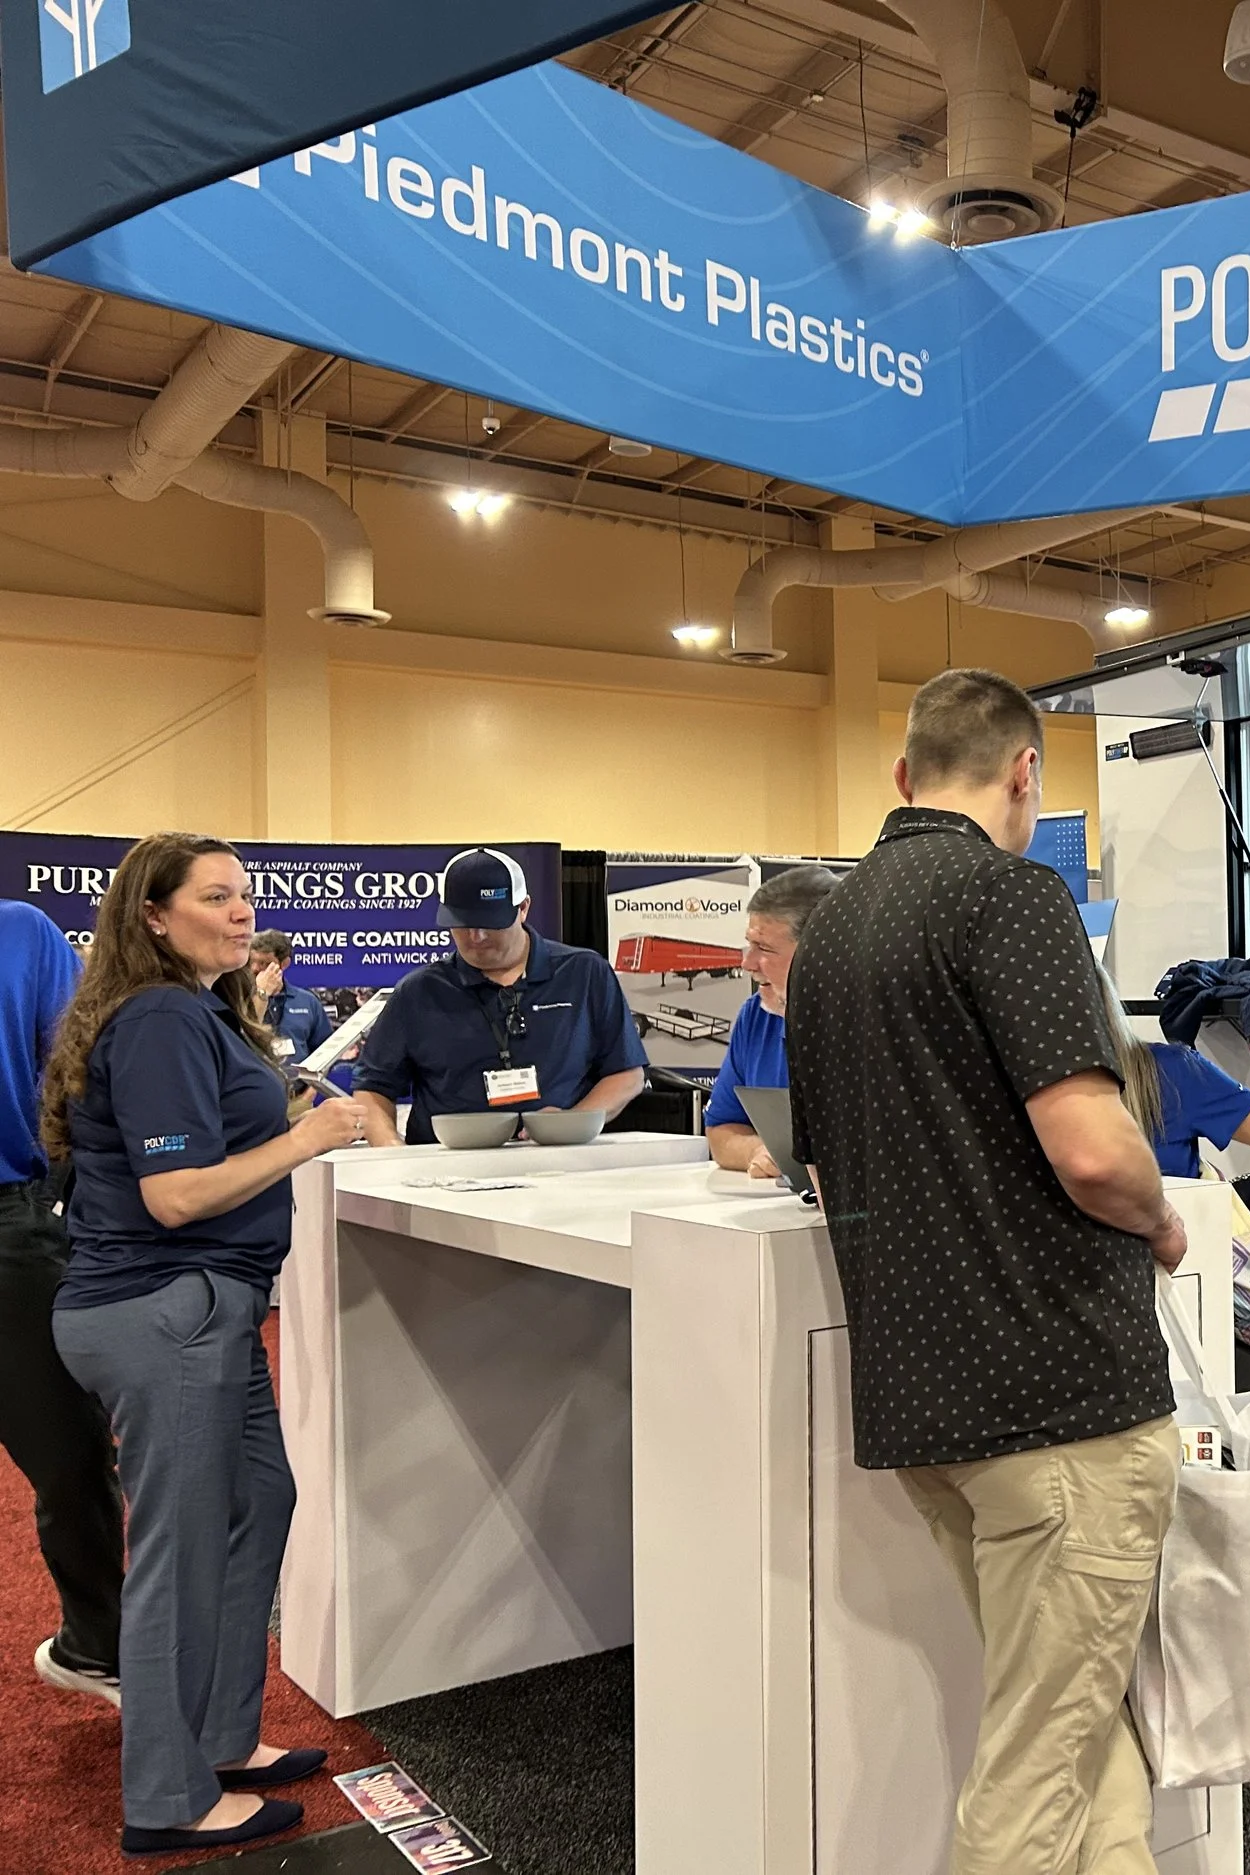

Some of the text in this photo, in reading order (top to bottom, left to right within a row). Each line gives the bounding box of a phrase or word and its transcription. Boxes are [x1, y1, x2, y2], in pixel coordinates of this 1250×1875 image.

[262, 861, 309, 871] ASPHALT
[312, 861, 363, 872] COMPANY
[27, 864, 120, 895] PUR
[293, 898, 356, 910] COATINGS
[358, 898, 395, 910] SINCE
[397, 898, 423, 910] 1927
[614, 899, 742, 915] Diamond Vogel
[288, 932, 348, 948] ATIVE
[352, 931, 451, 947] COATINGS
[294, 954, 343, 965] PRIMER
[361, 953, 392, 965] ANTI
[393, 953, 428, 965] WICK
